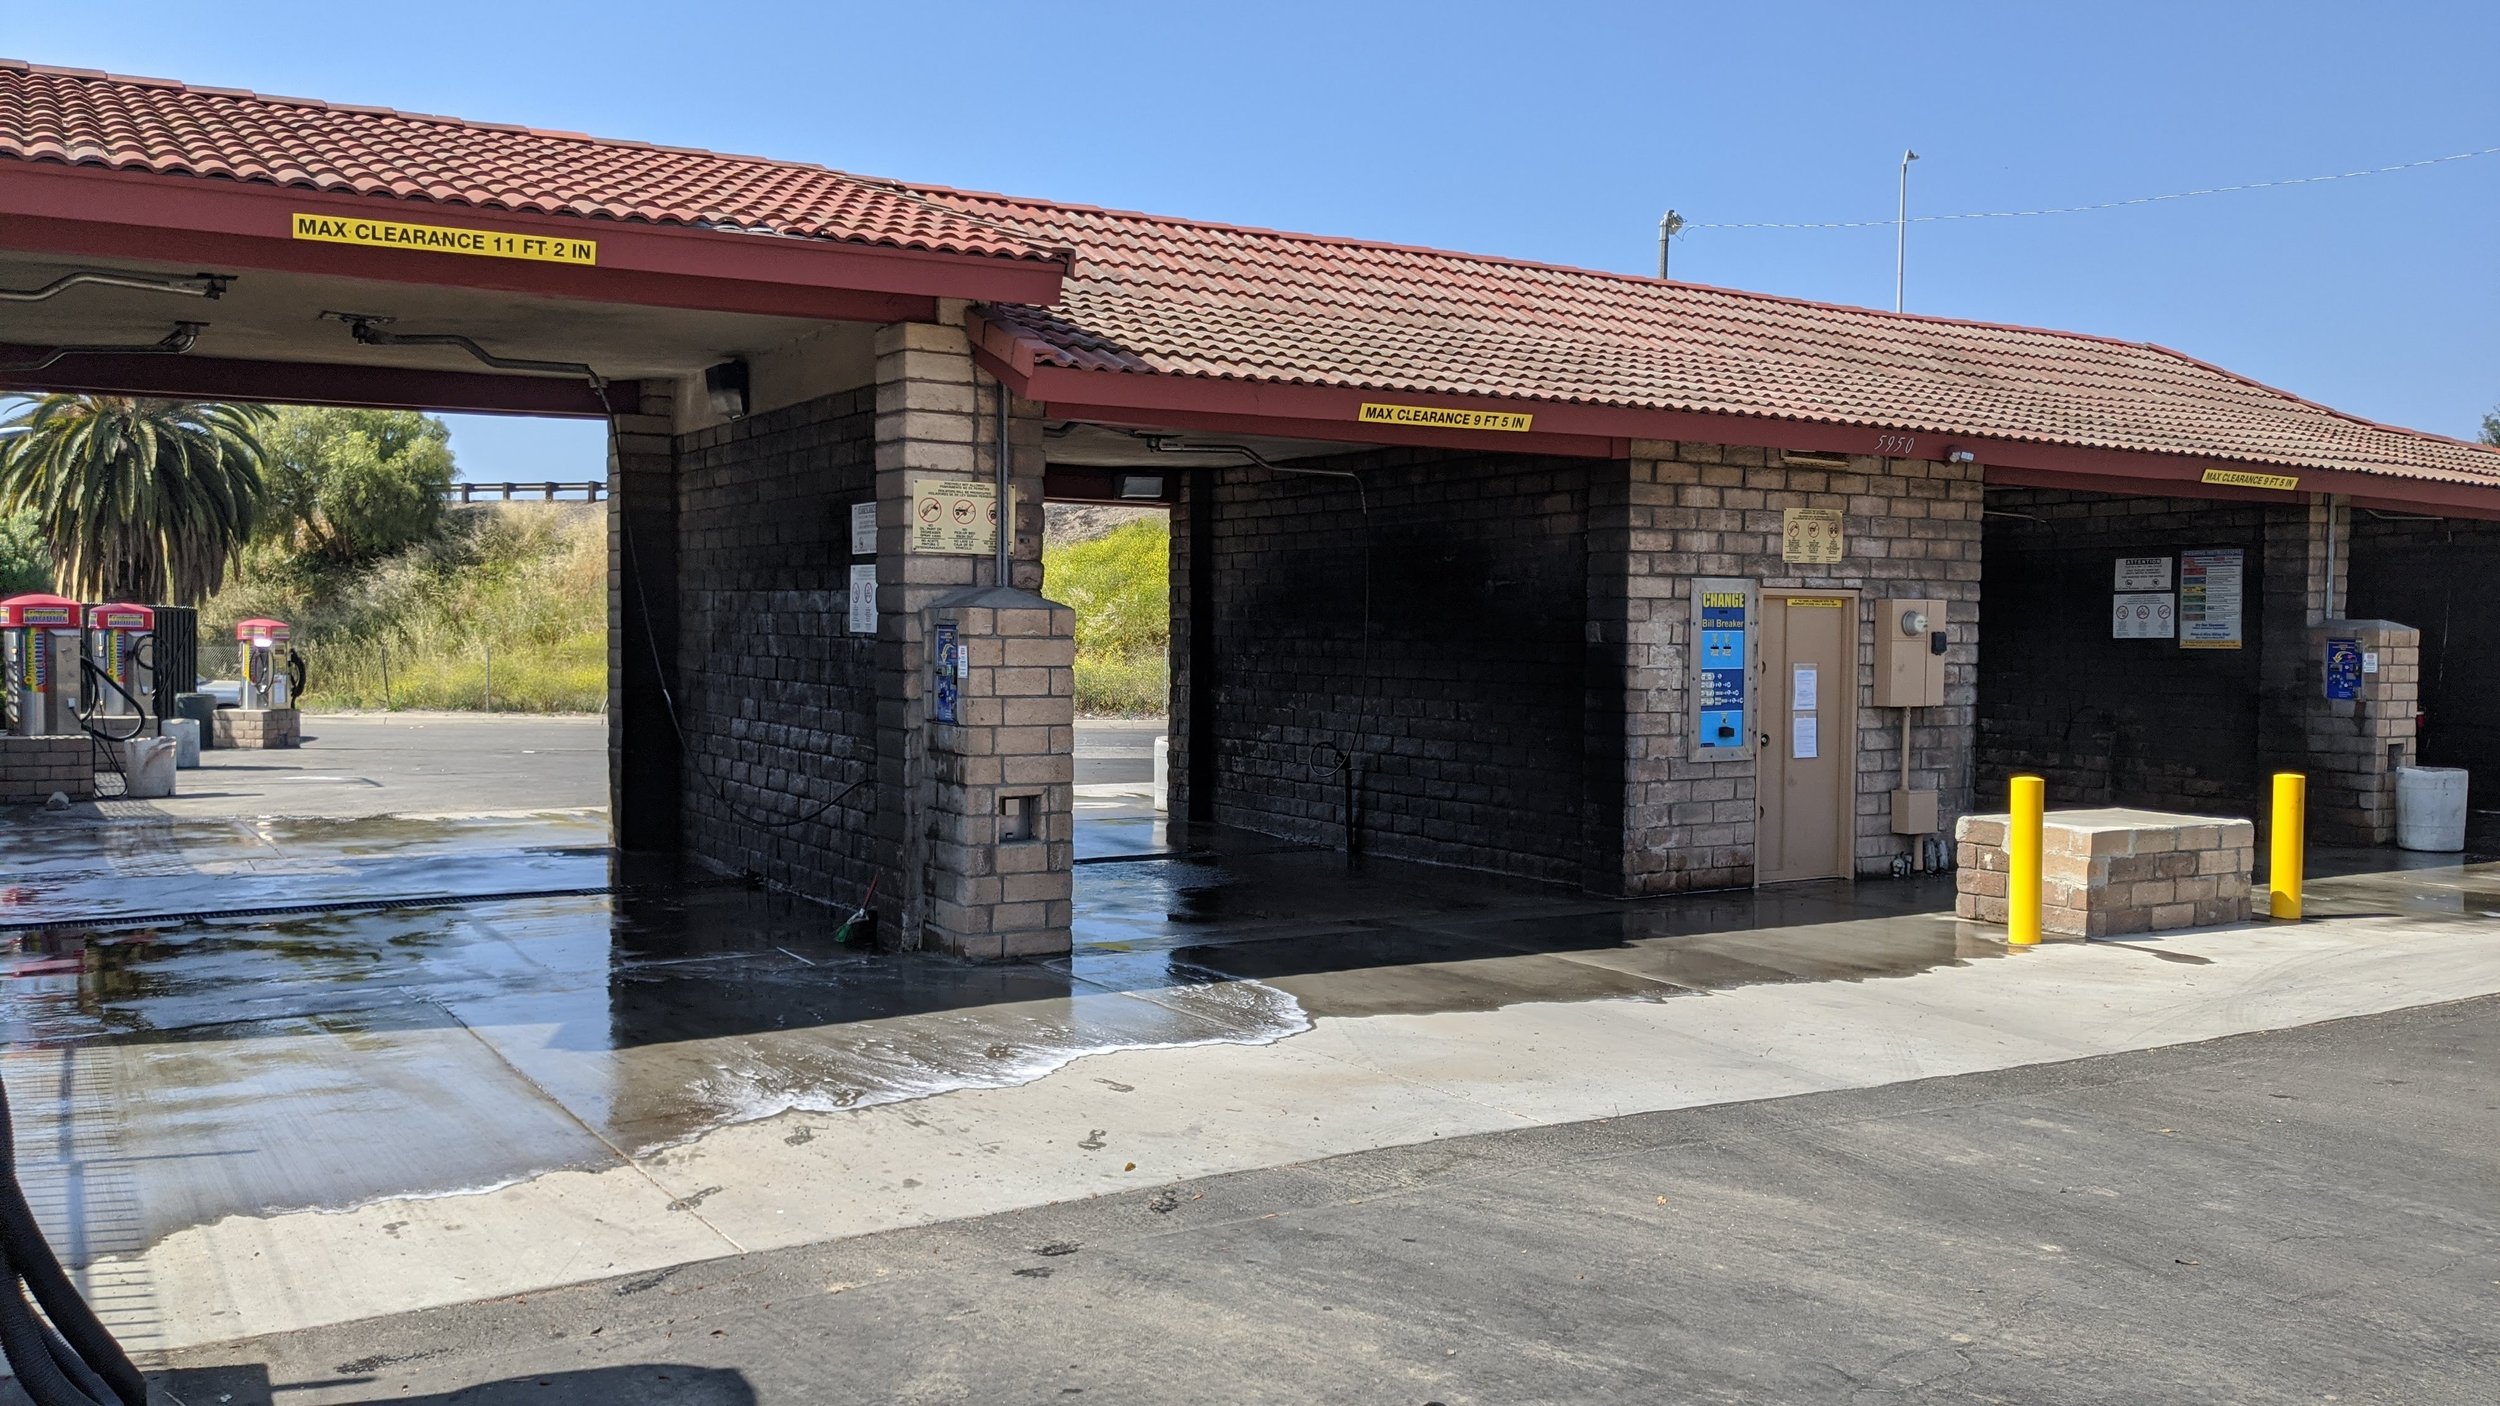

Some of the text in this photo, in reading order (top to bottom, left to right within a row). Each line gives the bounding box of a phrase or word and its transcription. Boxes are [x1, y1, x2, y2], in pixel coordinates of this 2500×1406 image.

[298, 218, 590, 260] MAX CLEARANCE 11 FT 2 IN
[1365, 407, 1524, 428] MAX CLEARANCE 9 FT 5 IN
[1874, 434, 1914, 454] 5950
[2206, 472, 2223, 482] MAX
[2222, 472, 2262, 484] CLEARANCE
[2269, 478, 2278, 486] FT
[2280, 478, 2284, 486] 5
[2285, 479, 2294, 488] IN
[1703, 593, 1744, 608] CHANGE
[1702, 619, 1744, 627] Bill Breaker
